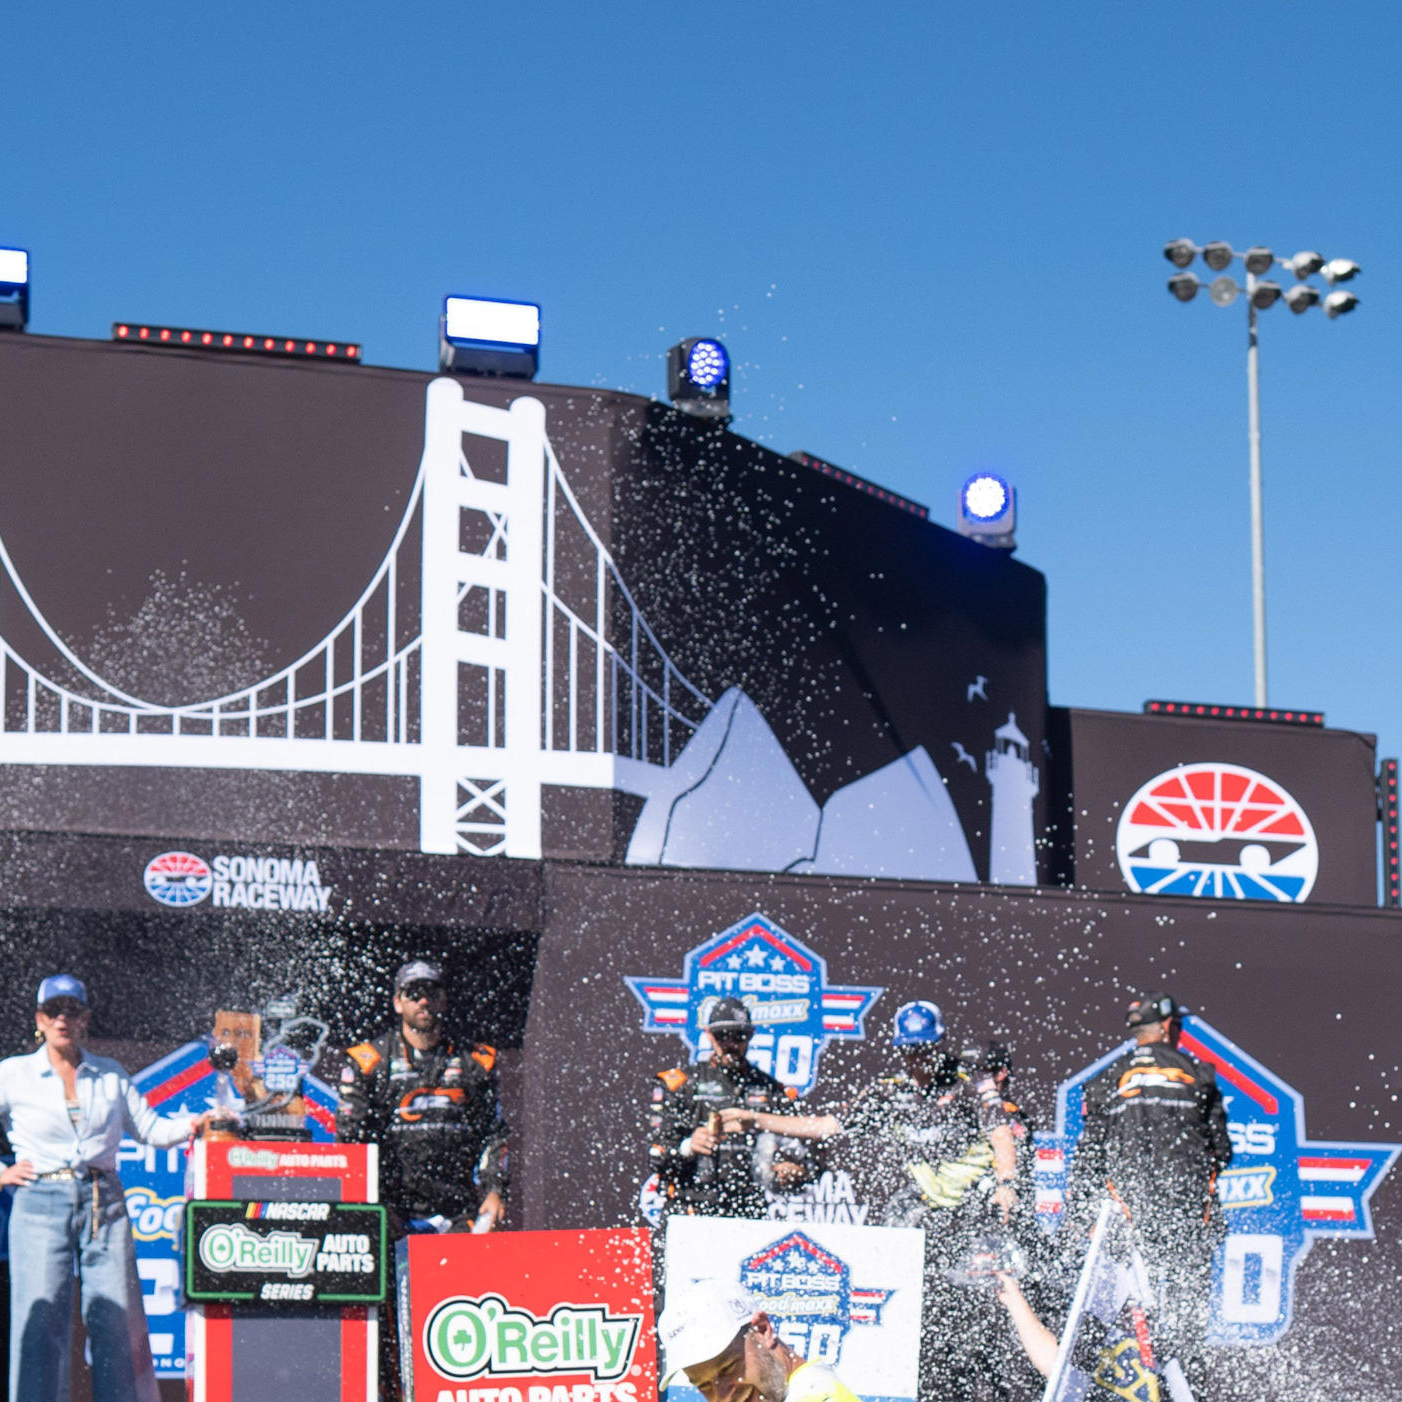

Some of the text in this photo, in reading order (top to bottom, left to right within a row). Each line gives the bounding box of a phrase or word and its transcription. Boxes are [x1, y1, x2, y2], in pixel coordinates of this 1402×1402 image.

[212, 855, 321, 886] SONOMA
[212, 882, 332, 911] RACEWAY
[699, 971, 810, 993] PIT BOSS
[265, 1202, 330, 1220] NASCAR
[206, 1230, 311, 1270] O'Reilly
[323, 1234, 370, 1254] AUTO
[317, 1253, 375, 1273] PARTS
[260, 1284, 315, 1300] SERIES
[436, 1306, 628, 1370] O'Reilly
[778, 1321, 842, 1366] 50
